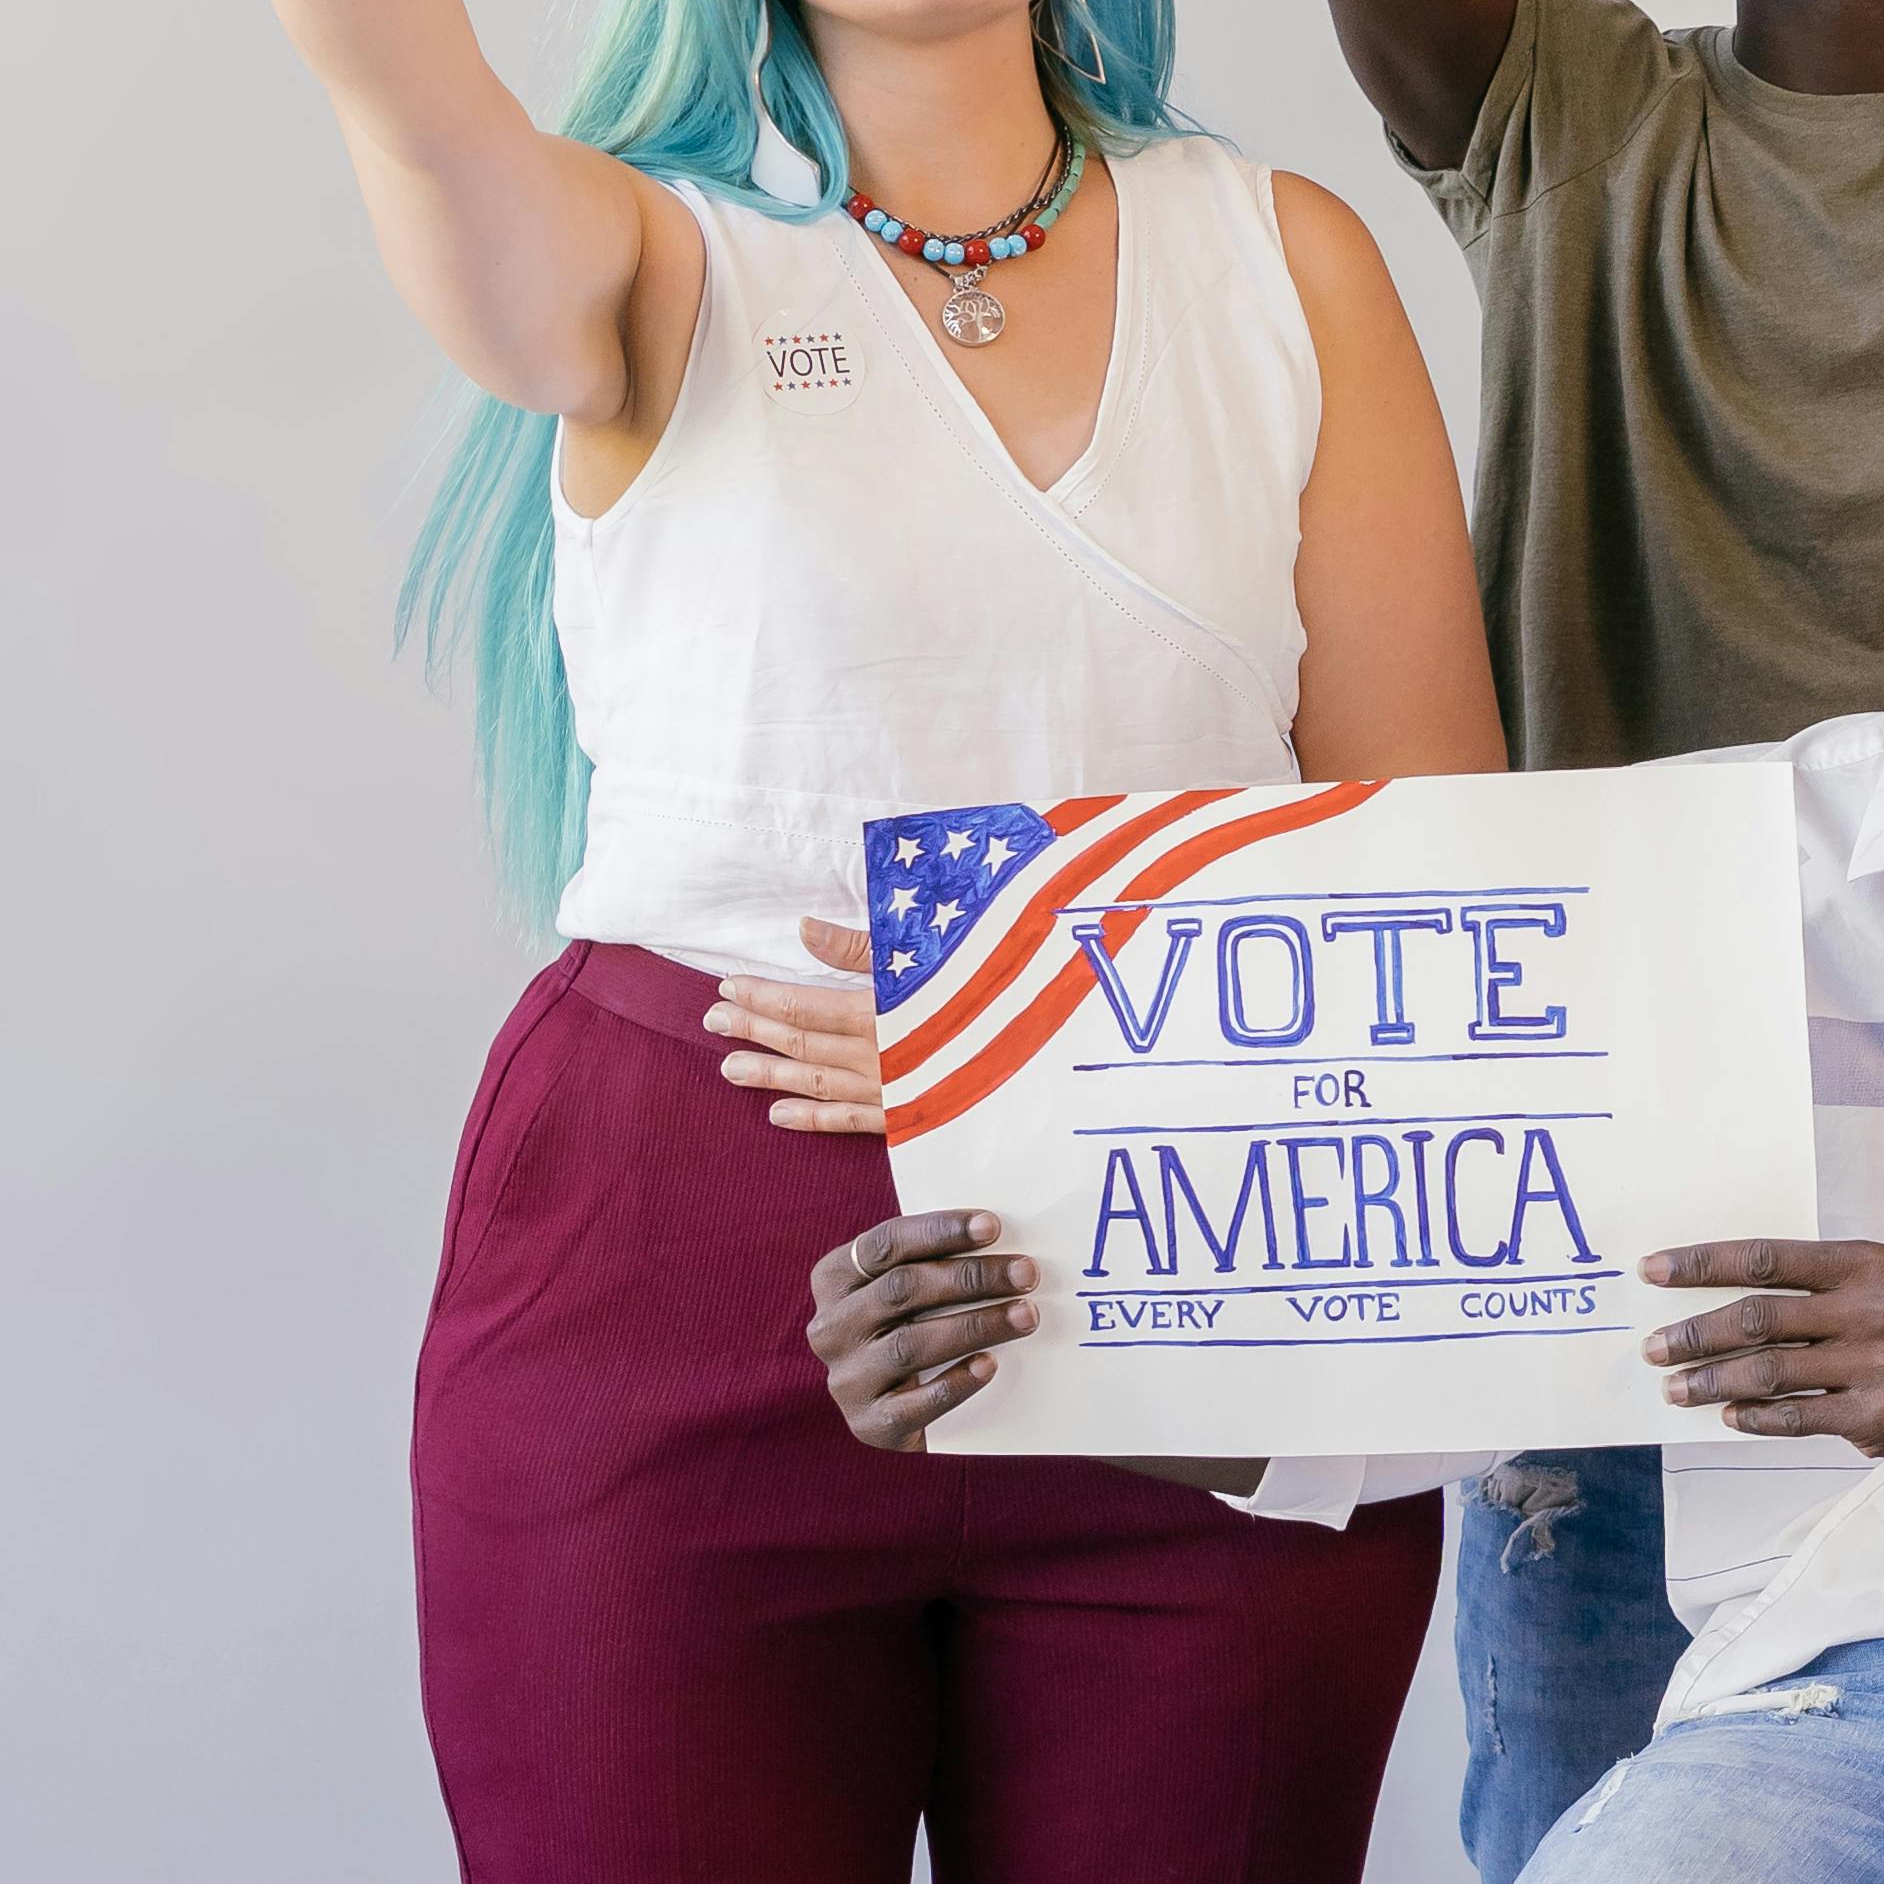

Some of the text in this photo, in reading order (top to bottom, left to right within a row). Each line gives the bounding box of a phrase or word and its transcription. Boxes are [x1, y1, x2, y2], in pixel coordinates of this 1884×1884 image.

[766, 346, 850, 378] VOTE
[1072, 903, 1567, 1054] VOTE
[1293, 1069, 1372, 1109] FOR
[1082, 1128, 1602, 1278] AMERICA
[1089, 1285, 1597, 1332] EVERY VOTE COUNTS
